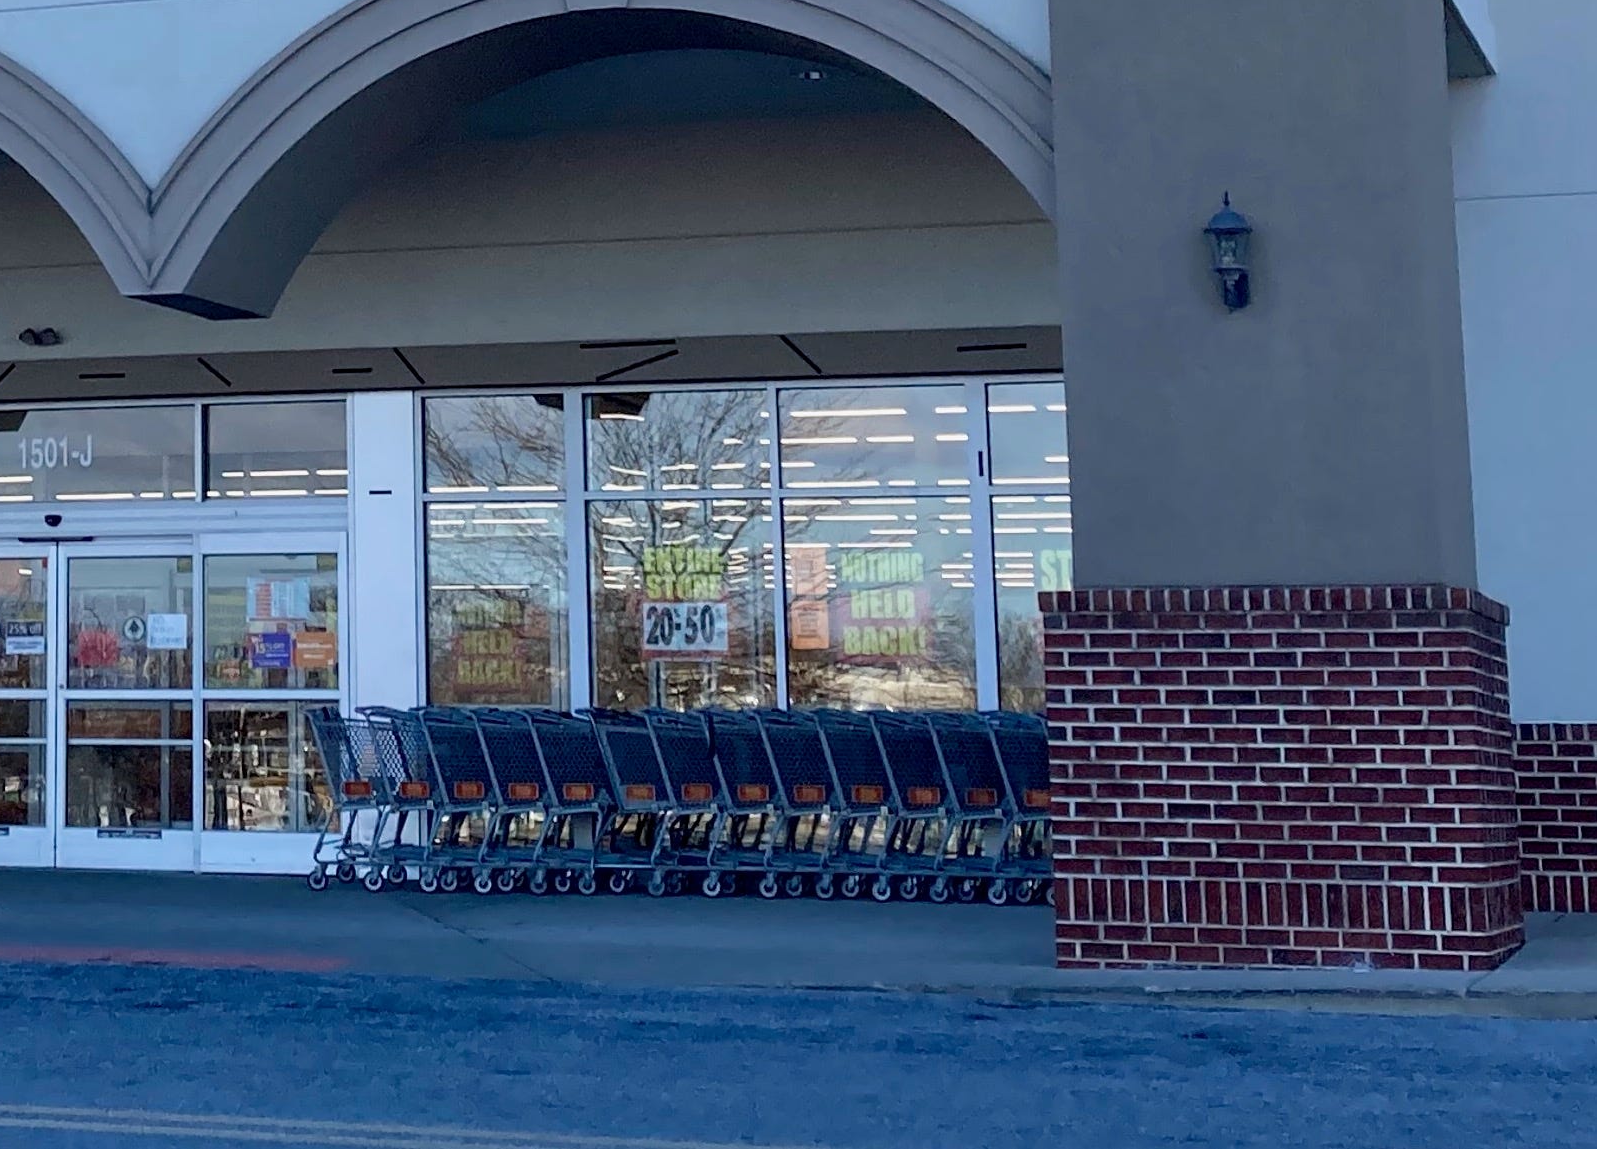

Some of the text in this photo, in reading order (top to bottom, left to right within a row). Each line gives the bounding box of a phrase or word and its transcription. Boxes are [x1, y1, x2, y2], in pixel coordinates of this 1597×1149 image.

[18, 434, 93, 469] 1501-J
[643, 547, 723, 573] ENTIRE
[841, 551, 924, 582] NOTHING
[645, 573, 721, 600] STORE
[850, 589, 916, 619] HELD
[843, 625, 927, 656] BACK!
